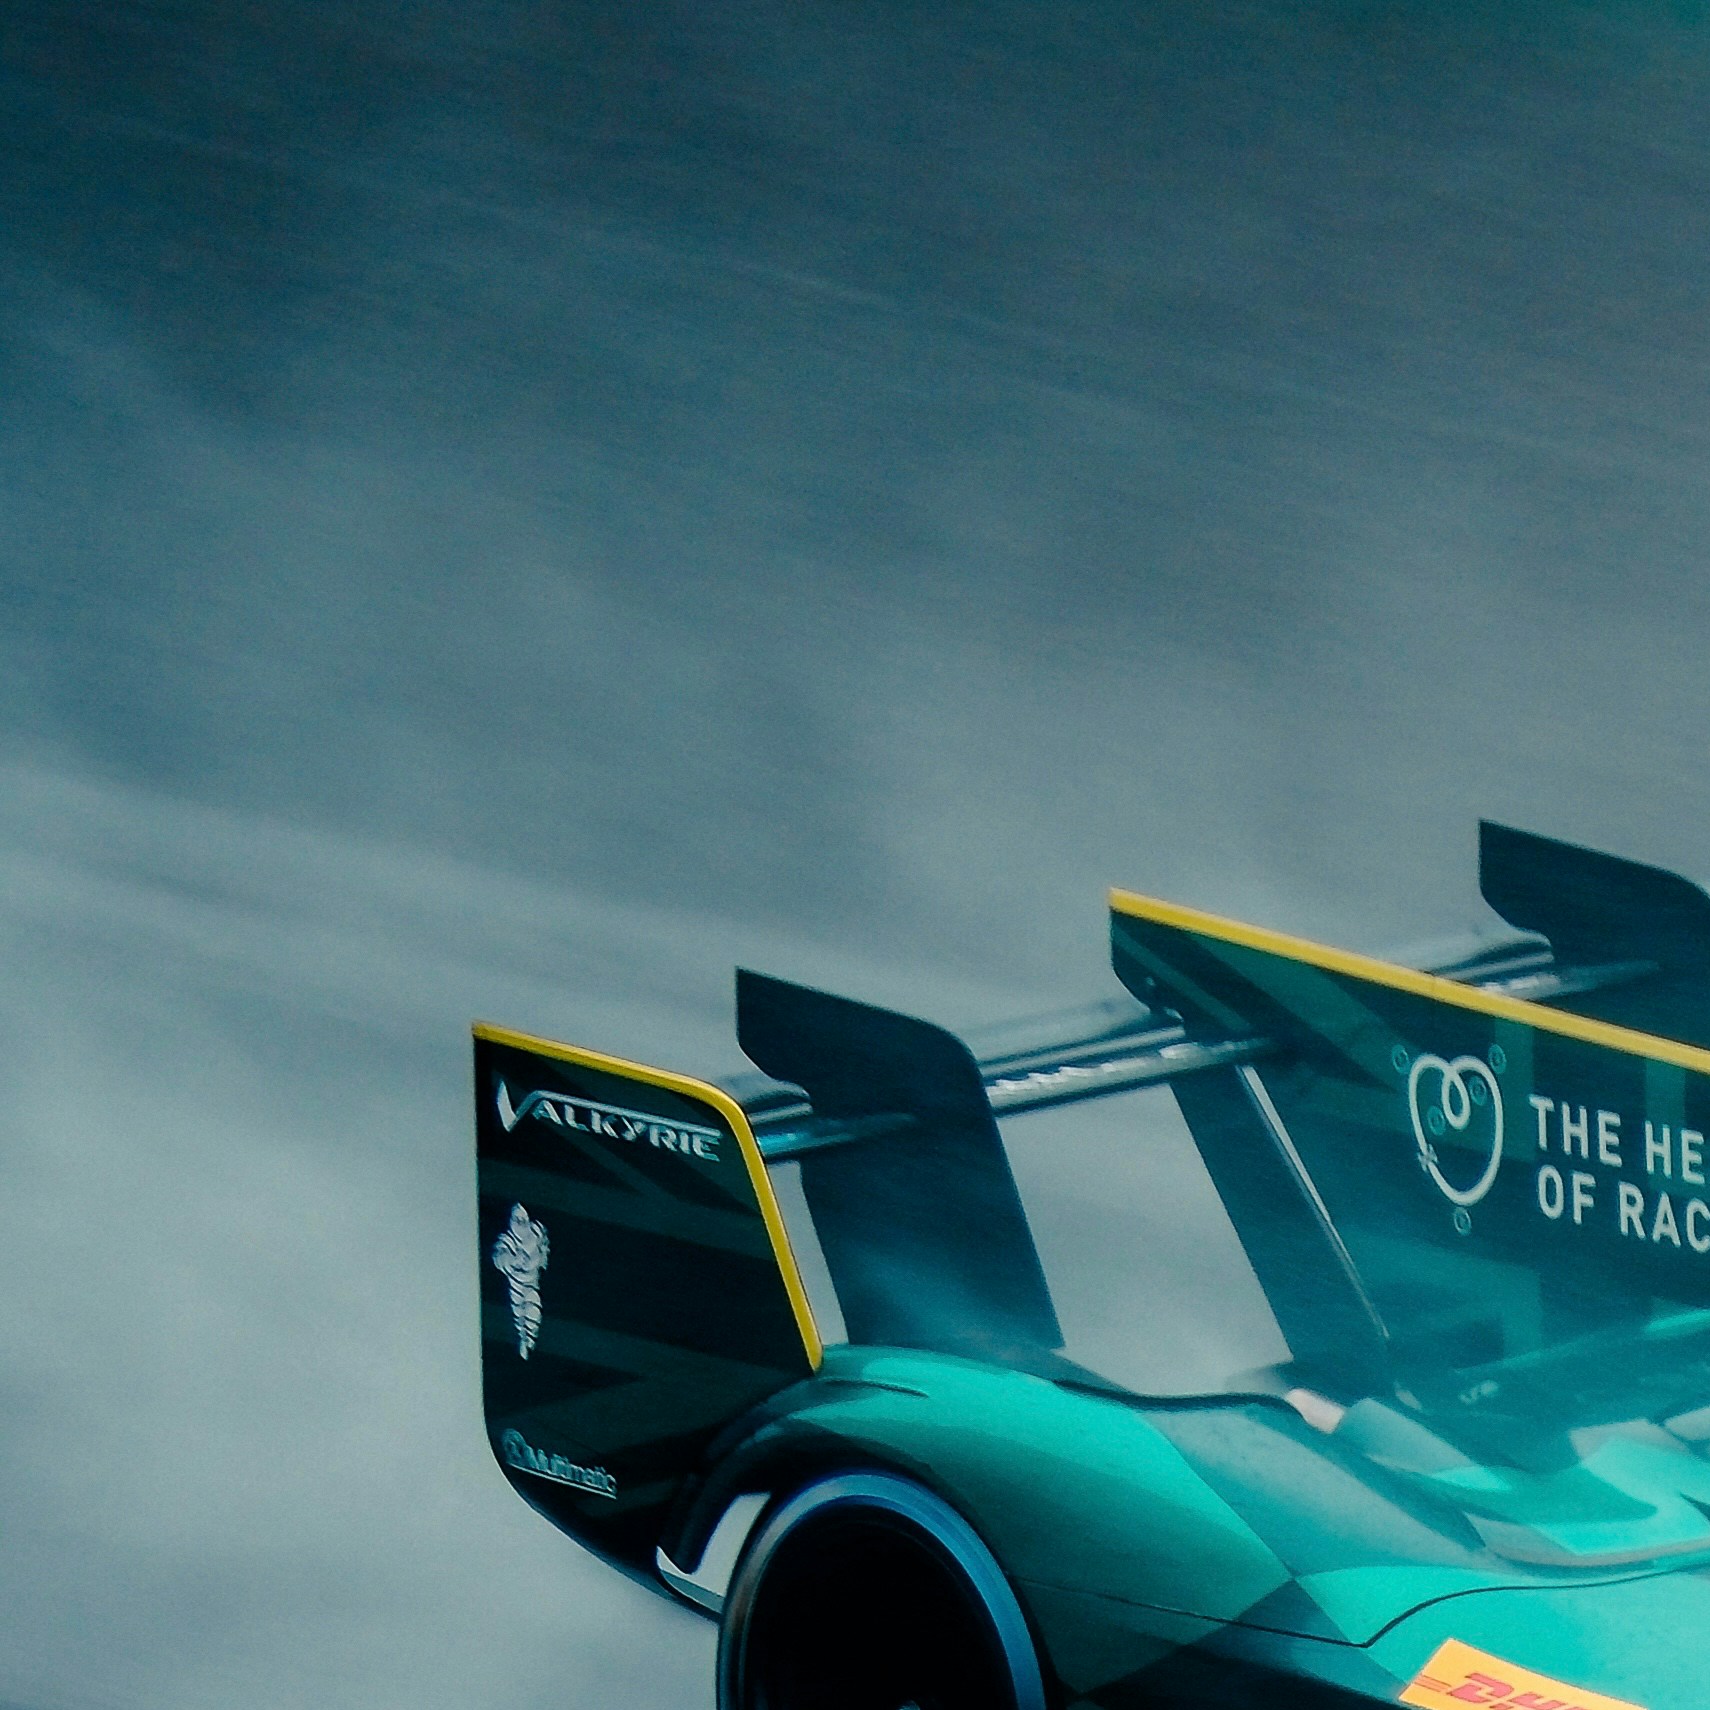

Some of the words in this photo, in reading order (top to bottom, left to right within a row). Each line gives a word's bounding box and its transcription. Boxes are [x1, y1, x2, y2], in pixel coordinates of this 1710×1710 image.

[497, 1080, 722, 1162] VALKYRIE
[1529, 1095, 1622, 1168] THE
[1537, 1164, 1596, 1225] OF
